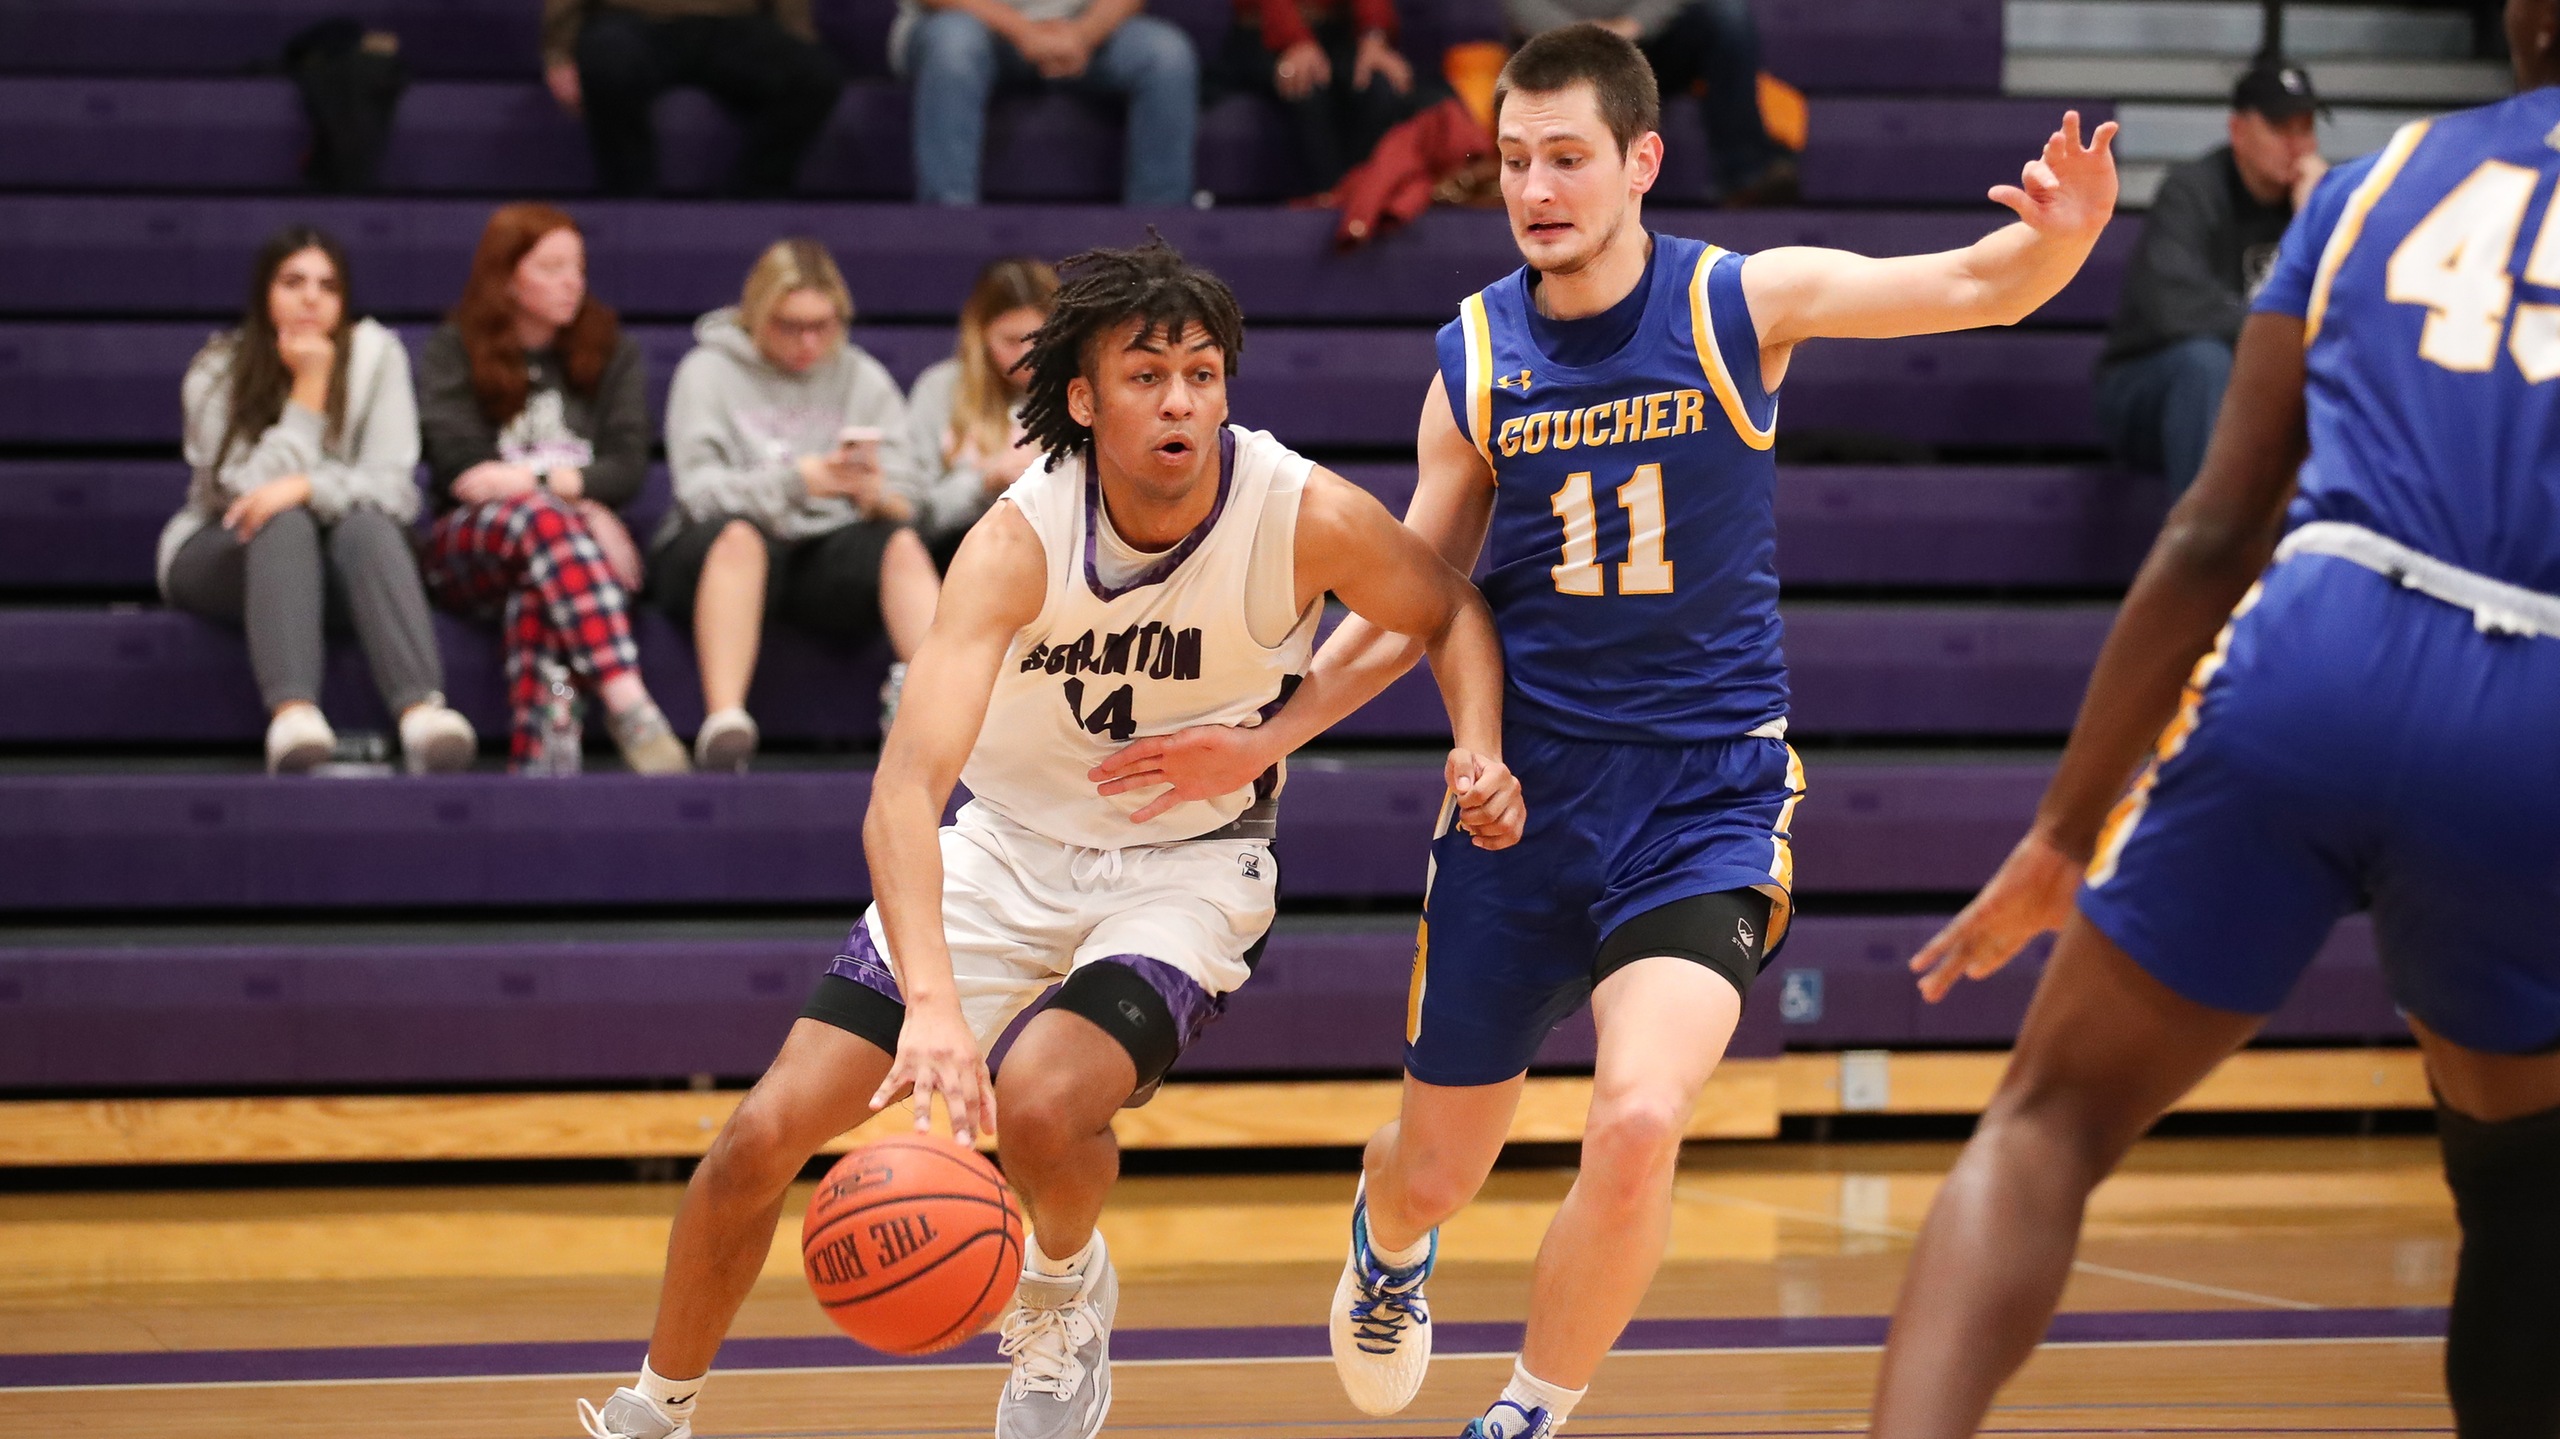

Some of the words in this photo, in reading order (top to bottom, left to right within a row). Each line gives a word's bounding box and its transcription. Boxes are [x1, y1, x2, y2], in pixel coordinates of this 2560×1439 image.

[1496, 388, 1705, 458] GOUCHER
[1550, 462, 1675, 597] 11
[1063, 676, 1138, 740] 14
[808, 1232, 868, 1286] ROCK
[868, 1213, 938, 1269] THE
